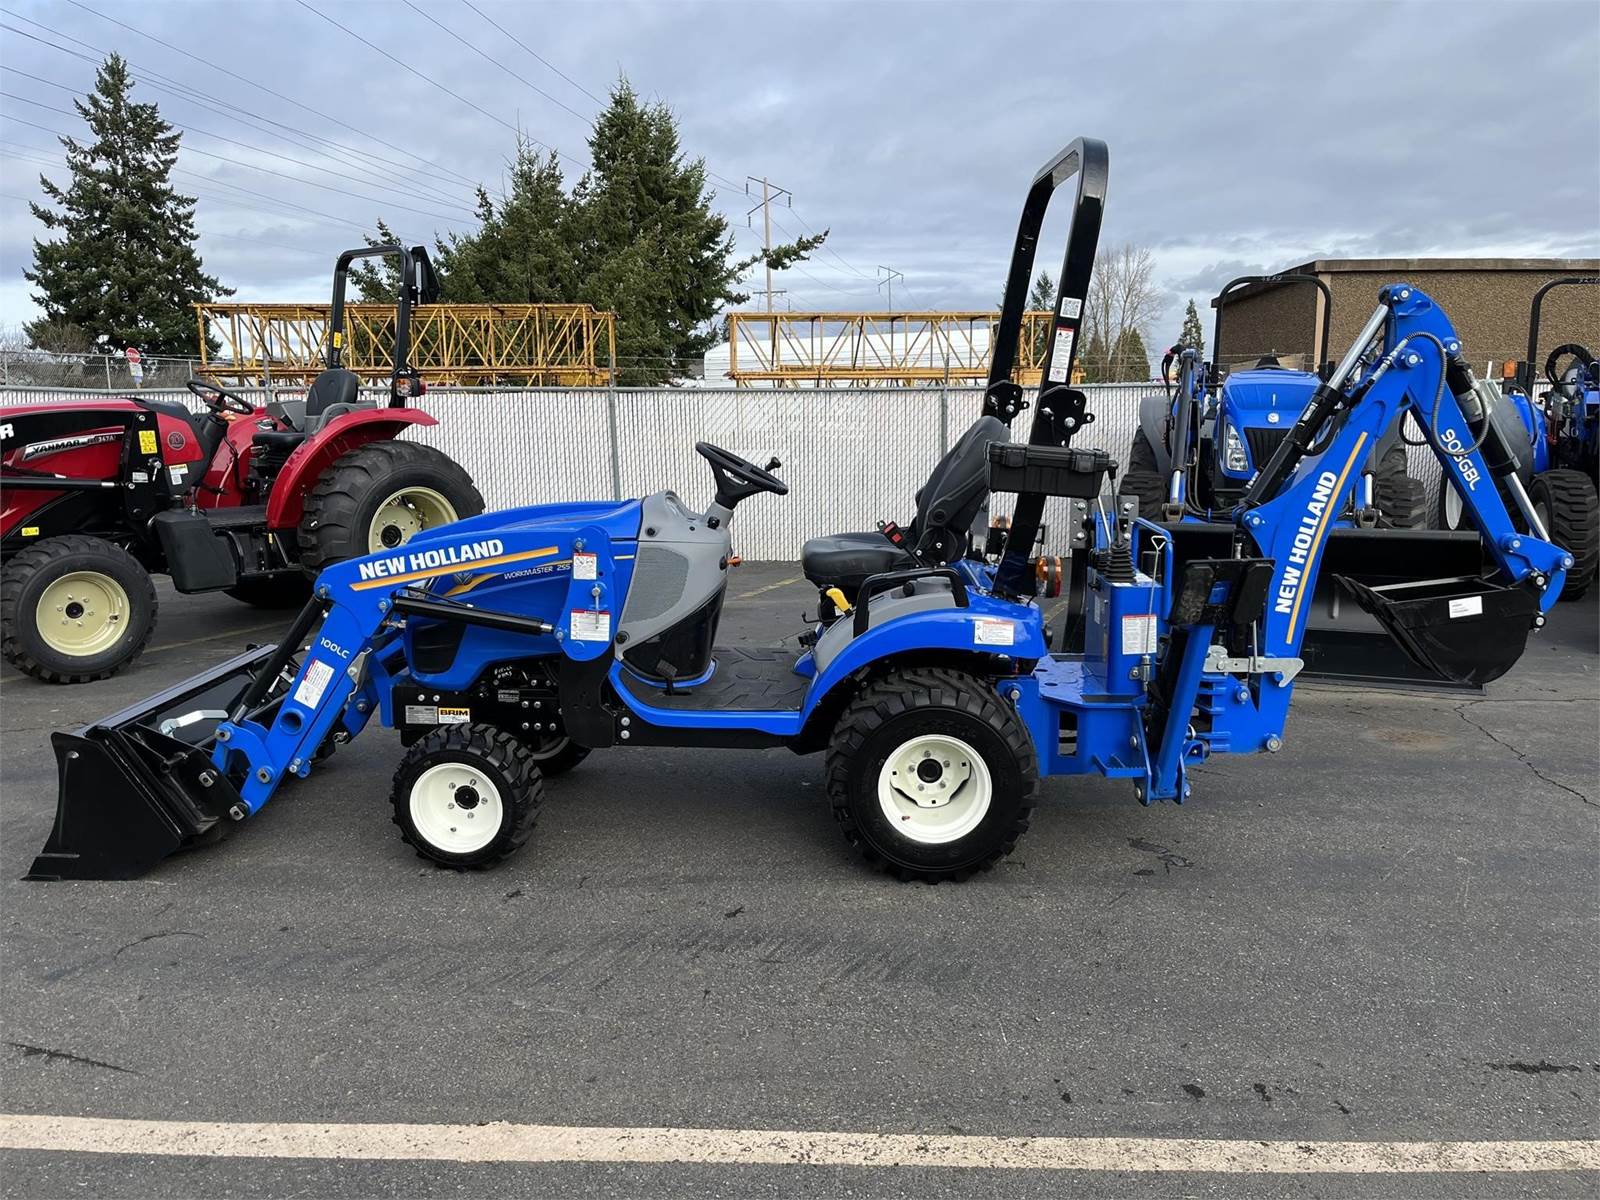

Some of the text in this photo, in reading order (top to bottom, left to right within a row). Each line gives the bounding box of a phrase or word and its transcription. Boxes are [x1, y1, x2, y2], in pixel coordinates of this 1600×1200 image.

[33, 439, 81, 453] YANMAR
[1274, 471, 1337, 614] NEW HOLLAND
[358, 539, 504, 581] NEW HOLLAND
[503, 565, 553, 580] WORKMASTER
[556, 563, 571, 572] 255
[320, 636, 350, 659] 100LC
